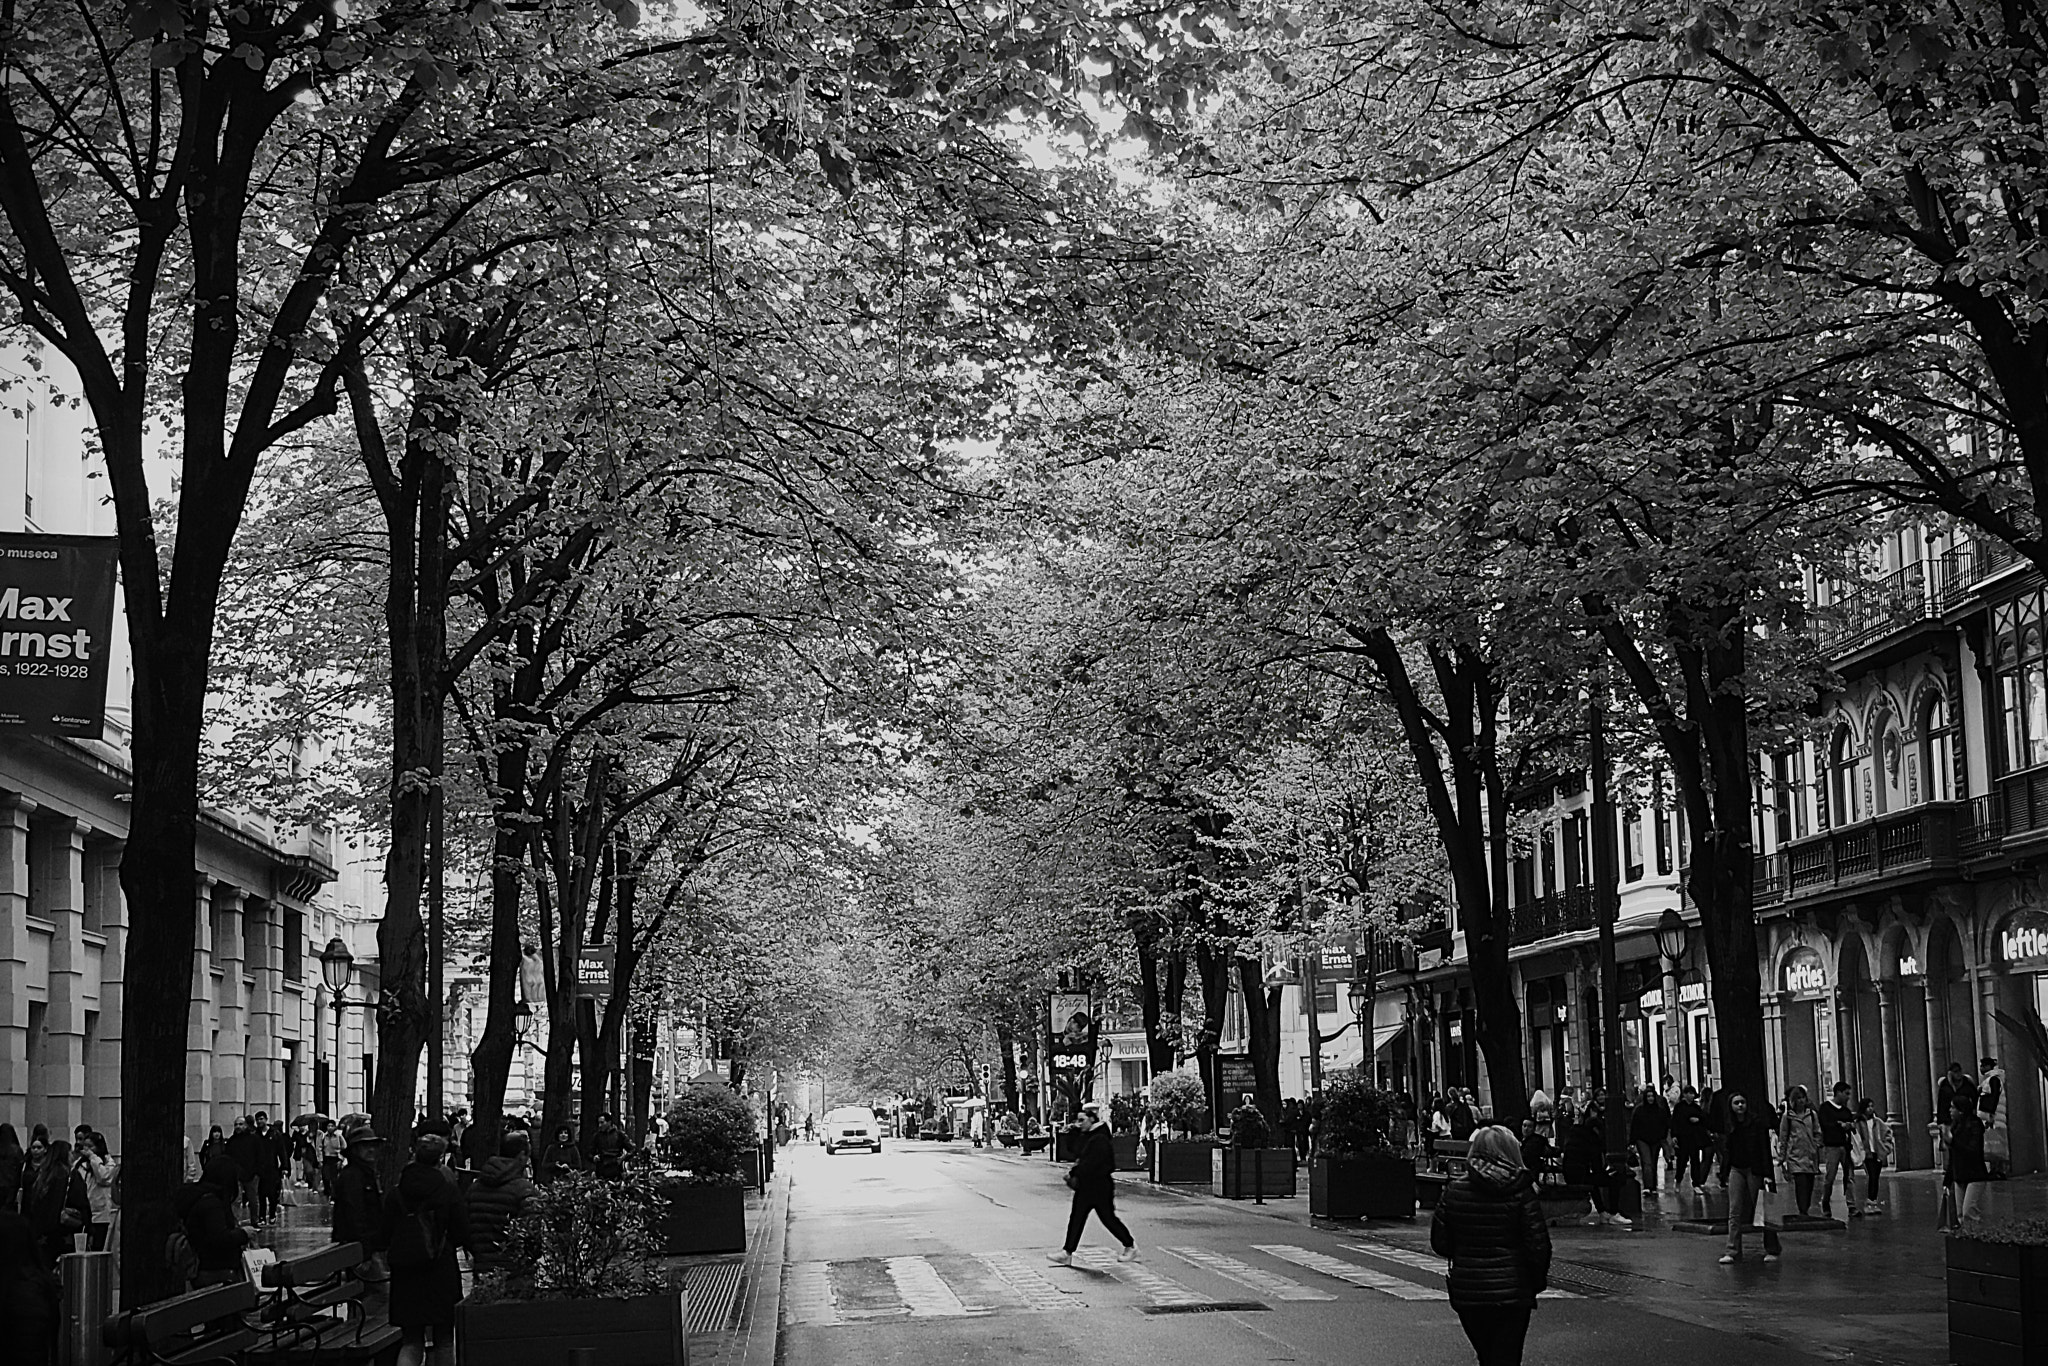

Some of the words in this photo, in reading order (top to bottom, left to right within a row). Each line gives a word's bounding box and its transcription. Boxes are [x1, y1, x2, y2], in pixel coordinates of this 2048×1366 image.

[7, 549, 58, 559] museoa
[15, 662, 89, 679] 1922-1928
[2002, 927, 2048, 960] leftie
[578, 959, 604, 969] Max
[1321, 953, 1353, 965] Ernst
[578, 969, 610, 979] Ernst
[1786, 964, 1825, 991] lefties
[1679, 982, 1705, 1002] PRIMOR
[1118, 1042, 1146, 1055] kutxa
[1053, 1054, 1087, 1068] 18:48
